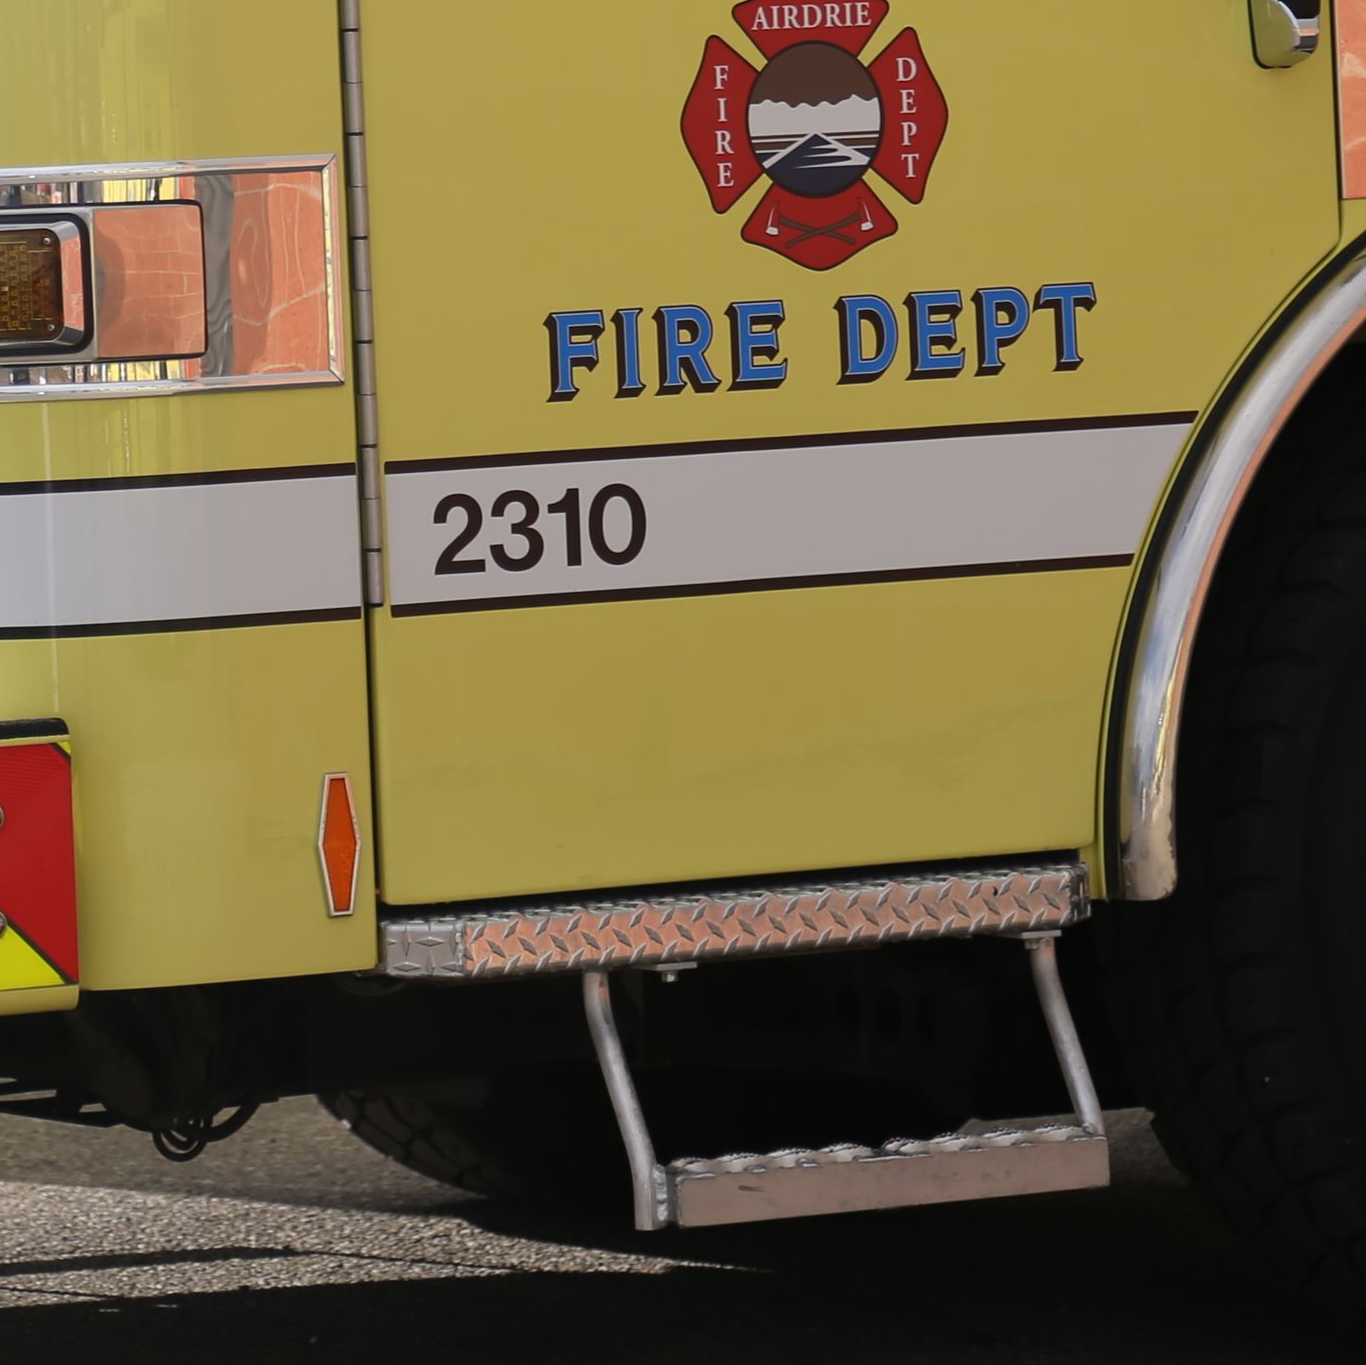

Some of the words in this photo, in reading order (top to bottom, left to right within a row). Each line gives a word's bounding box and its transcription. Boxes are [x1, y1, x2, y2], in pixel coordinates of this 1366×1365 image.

[751, 1, 871, 30] AIRDRIE
[713, 65, 735, 187] FIRE
[895, 57, 920, 178] DEPT
[543, 299, 789, 403] FIRE
[834, 281, 1097, 386] DEPT
[433, 483, 647, 575] 2310
